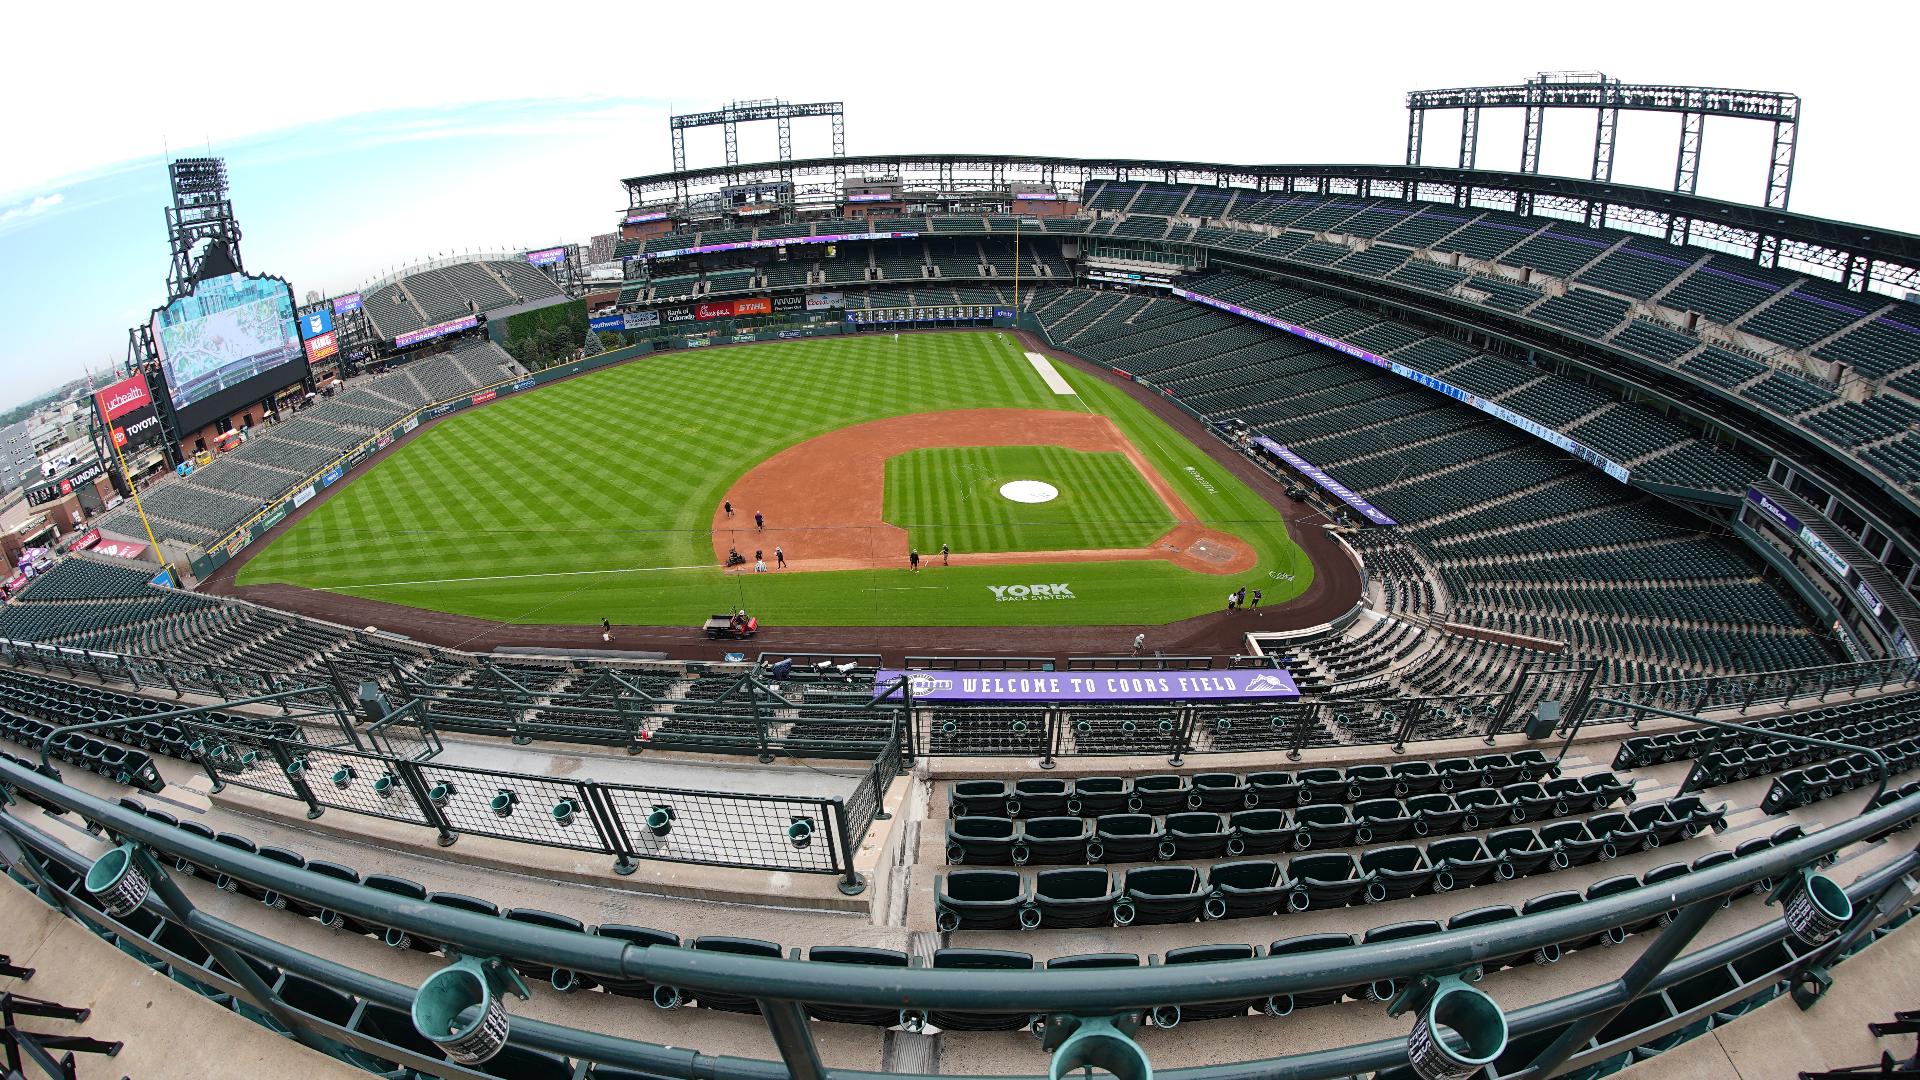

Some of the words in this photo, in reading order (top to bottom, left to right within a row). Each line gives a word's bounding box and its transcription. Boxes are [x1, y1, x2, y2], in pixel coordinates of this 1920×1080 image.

[739, 303, 767, 311] STIHL
[668, 312, 695, 322] Colorado
[590, 320, 620, 330] Southwest
[107, 386, 144, 412] uchealth
[126, 415, 158, 436] TOYOTA
[70, 465, 101, 487] TUNDRA
[987, 583, 1074, 598] YORK
[963, 678, 1060, 693] WELCOME
[1071, 678, 1096, 693] TO
[1107, 678, 1169, 693] COORS
[1178, 677, 1237, 692] FIELD
